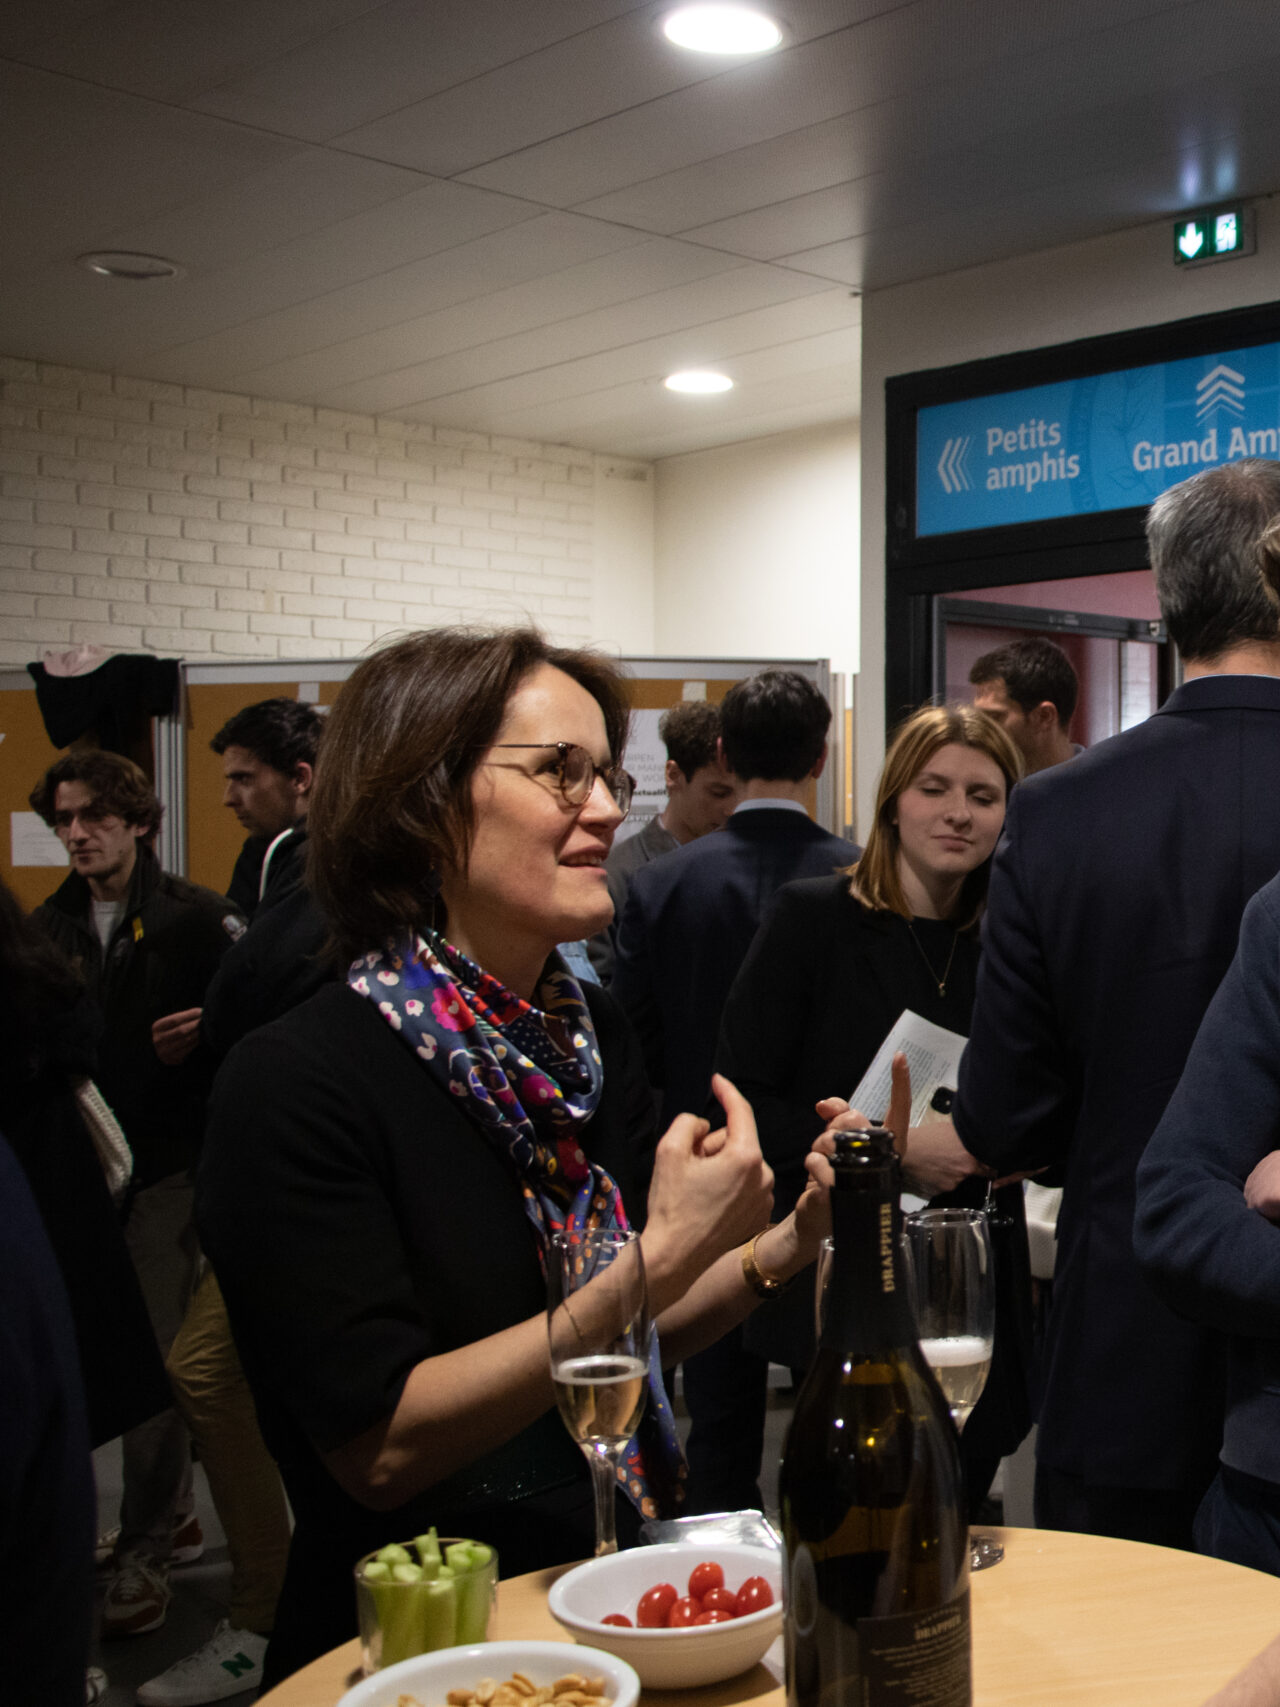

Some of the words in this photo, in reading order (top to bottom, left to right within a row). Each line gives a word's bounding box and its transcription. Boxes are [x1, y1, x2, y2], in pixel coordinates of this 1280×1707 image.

[986, 418, 1061, 456] Petits
[1132, 428, 1218, 472] Grand
[986, 448, 1080, 493] amphis
[880, 1202, 896, 1293] DRAPPIER
